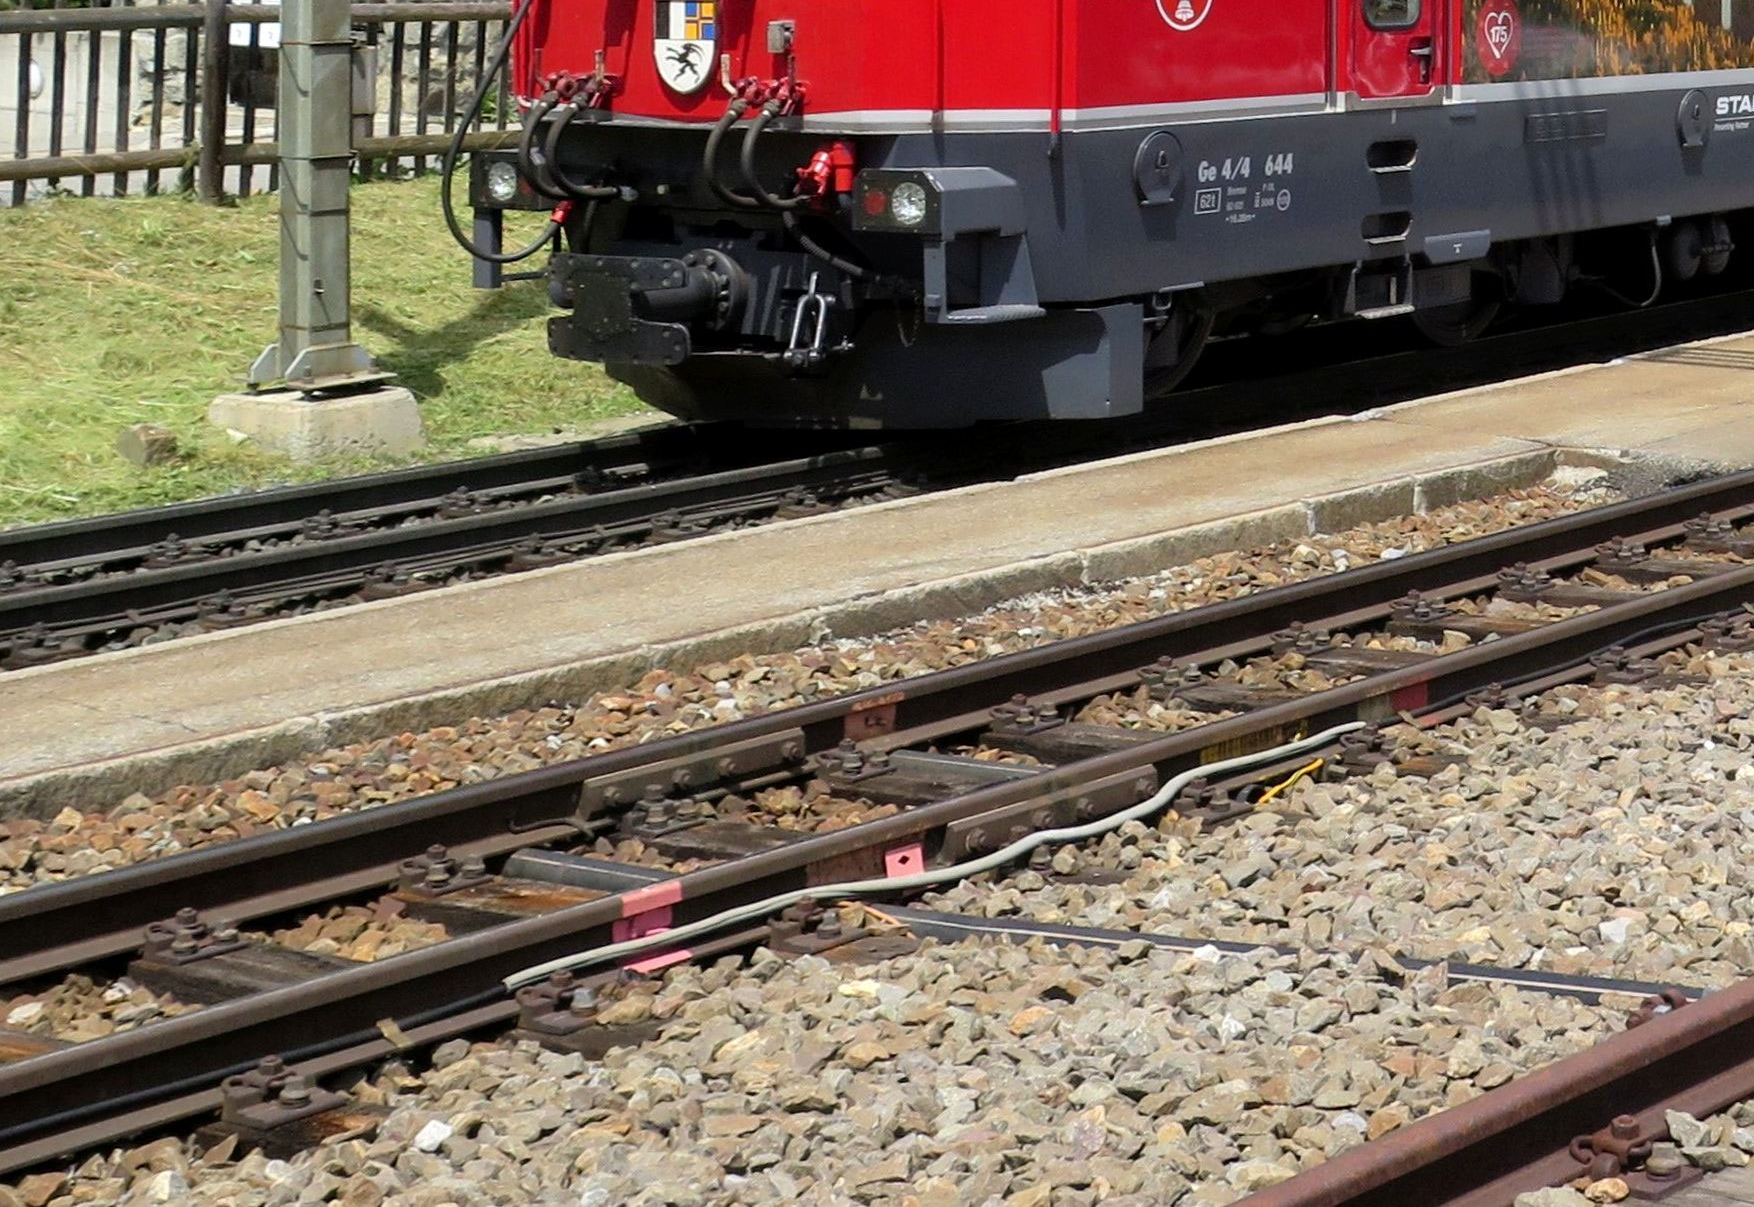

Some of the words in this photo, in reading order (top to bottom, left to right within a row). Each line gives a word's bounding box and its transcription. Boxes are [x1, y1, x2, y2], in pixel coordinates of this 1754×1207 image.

[1490, 26, 1508, 43] 175
[1198, 160, 1218, 182] Ge
[1221, 156, 1251, 181] 4/4
[1264, 153, 1294, 176] 644
[1200, 194, 1217, 210] 62t
